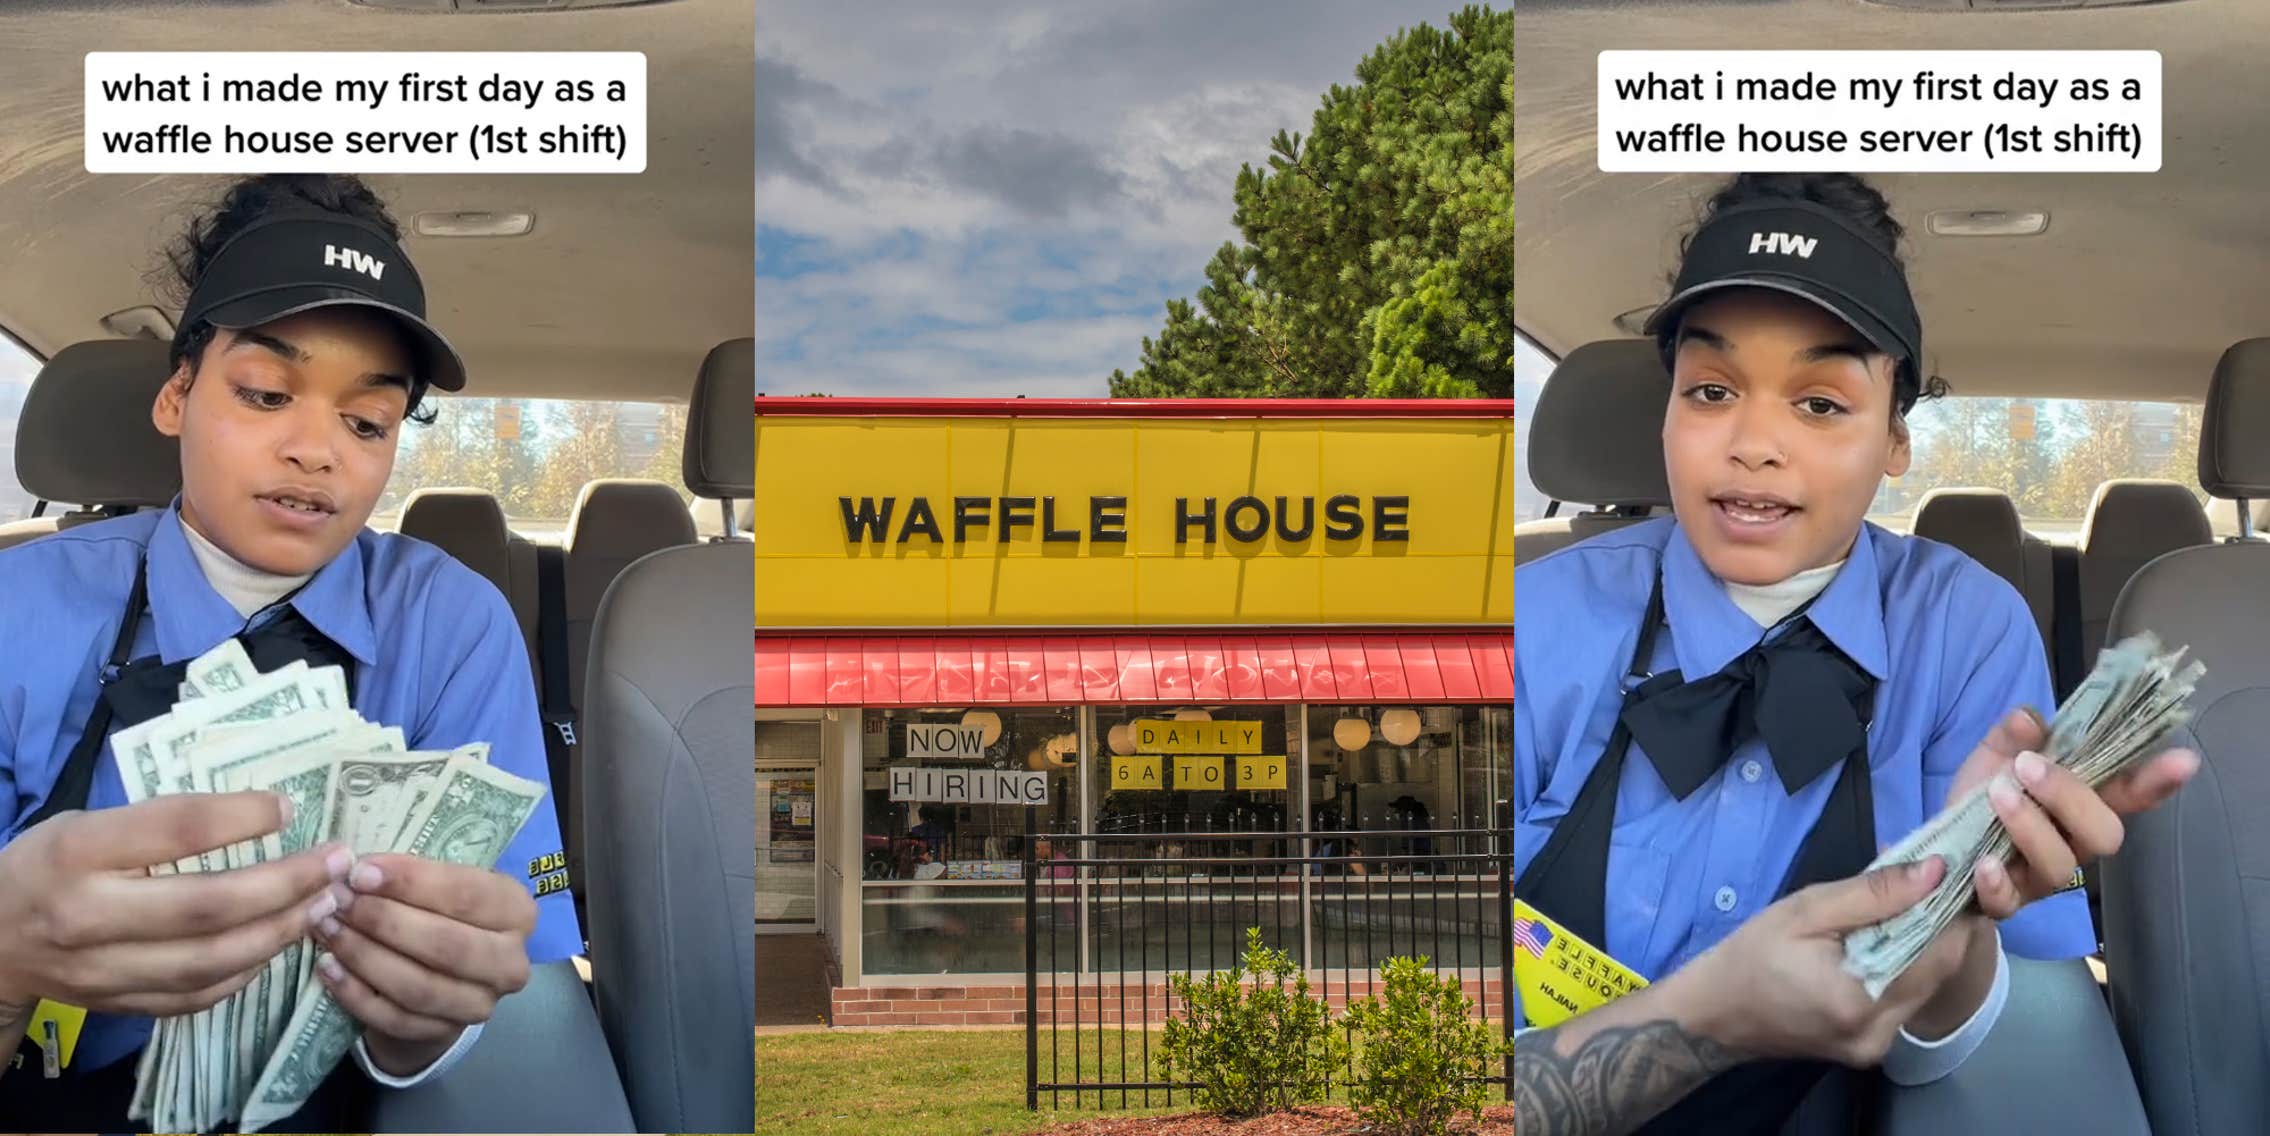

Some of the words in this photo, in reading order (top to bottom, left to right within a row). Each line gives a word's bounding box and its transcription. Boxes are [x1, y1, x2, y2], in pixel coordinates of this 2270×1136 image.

[839, 496, 1127, 543] WAFFLE
[1176, 495, 1409, 543] HOUSE
[911, 728, 983, 753] NOW
[1143, 728, 1253, 745] DAILY
[1118, 765, 1155, 781] 6A
[1180, 766, 1219, 782] TO
[1243, 764, 1278, 780] 3P
[893, 771, 1045, 801] HIRING
